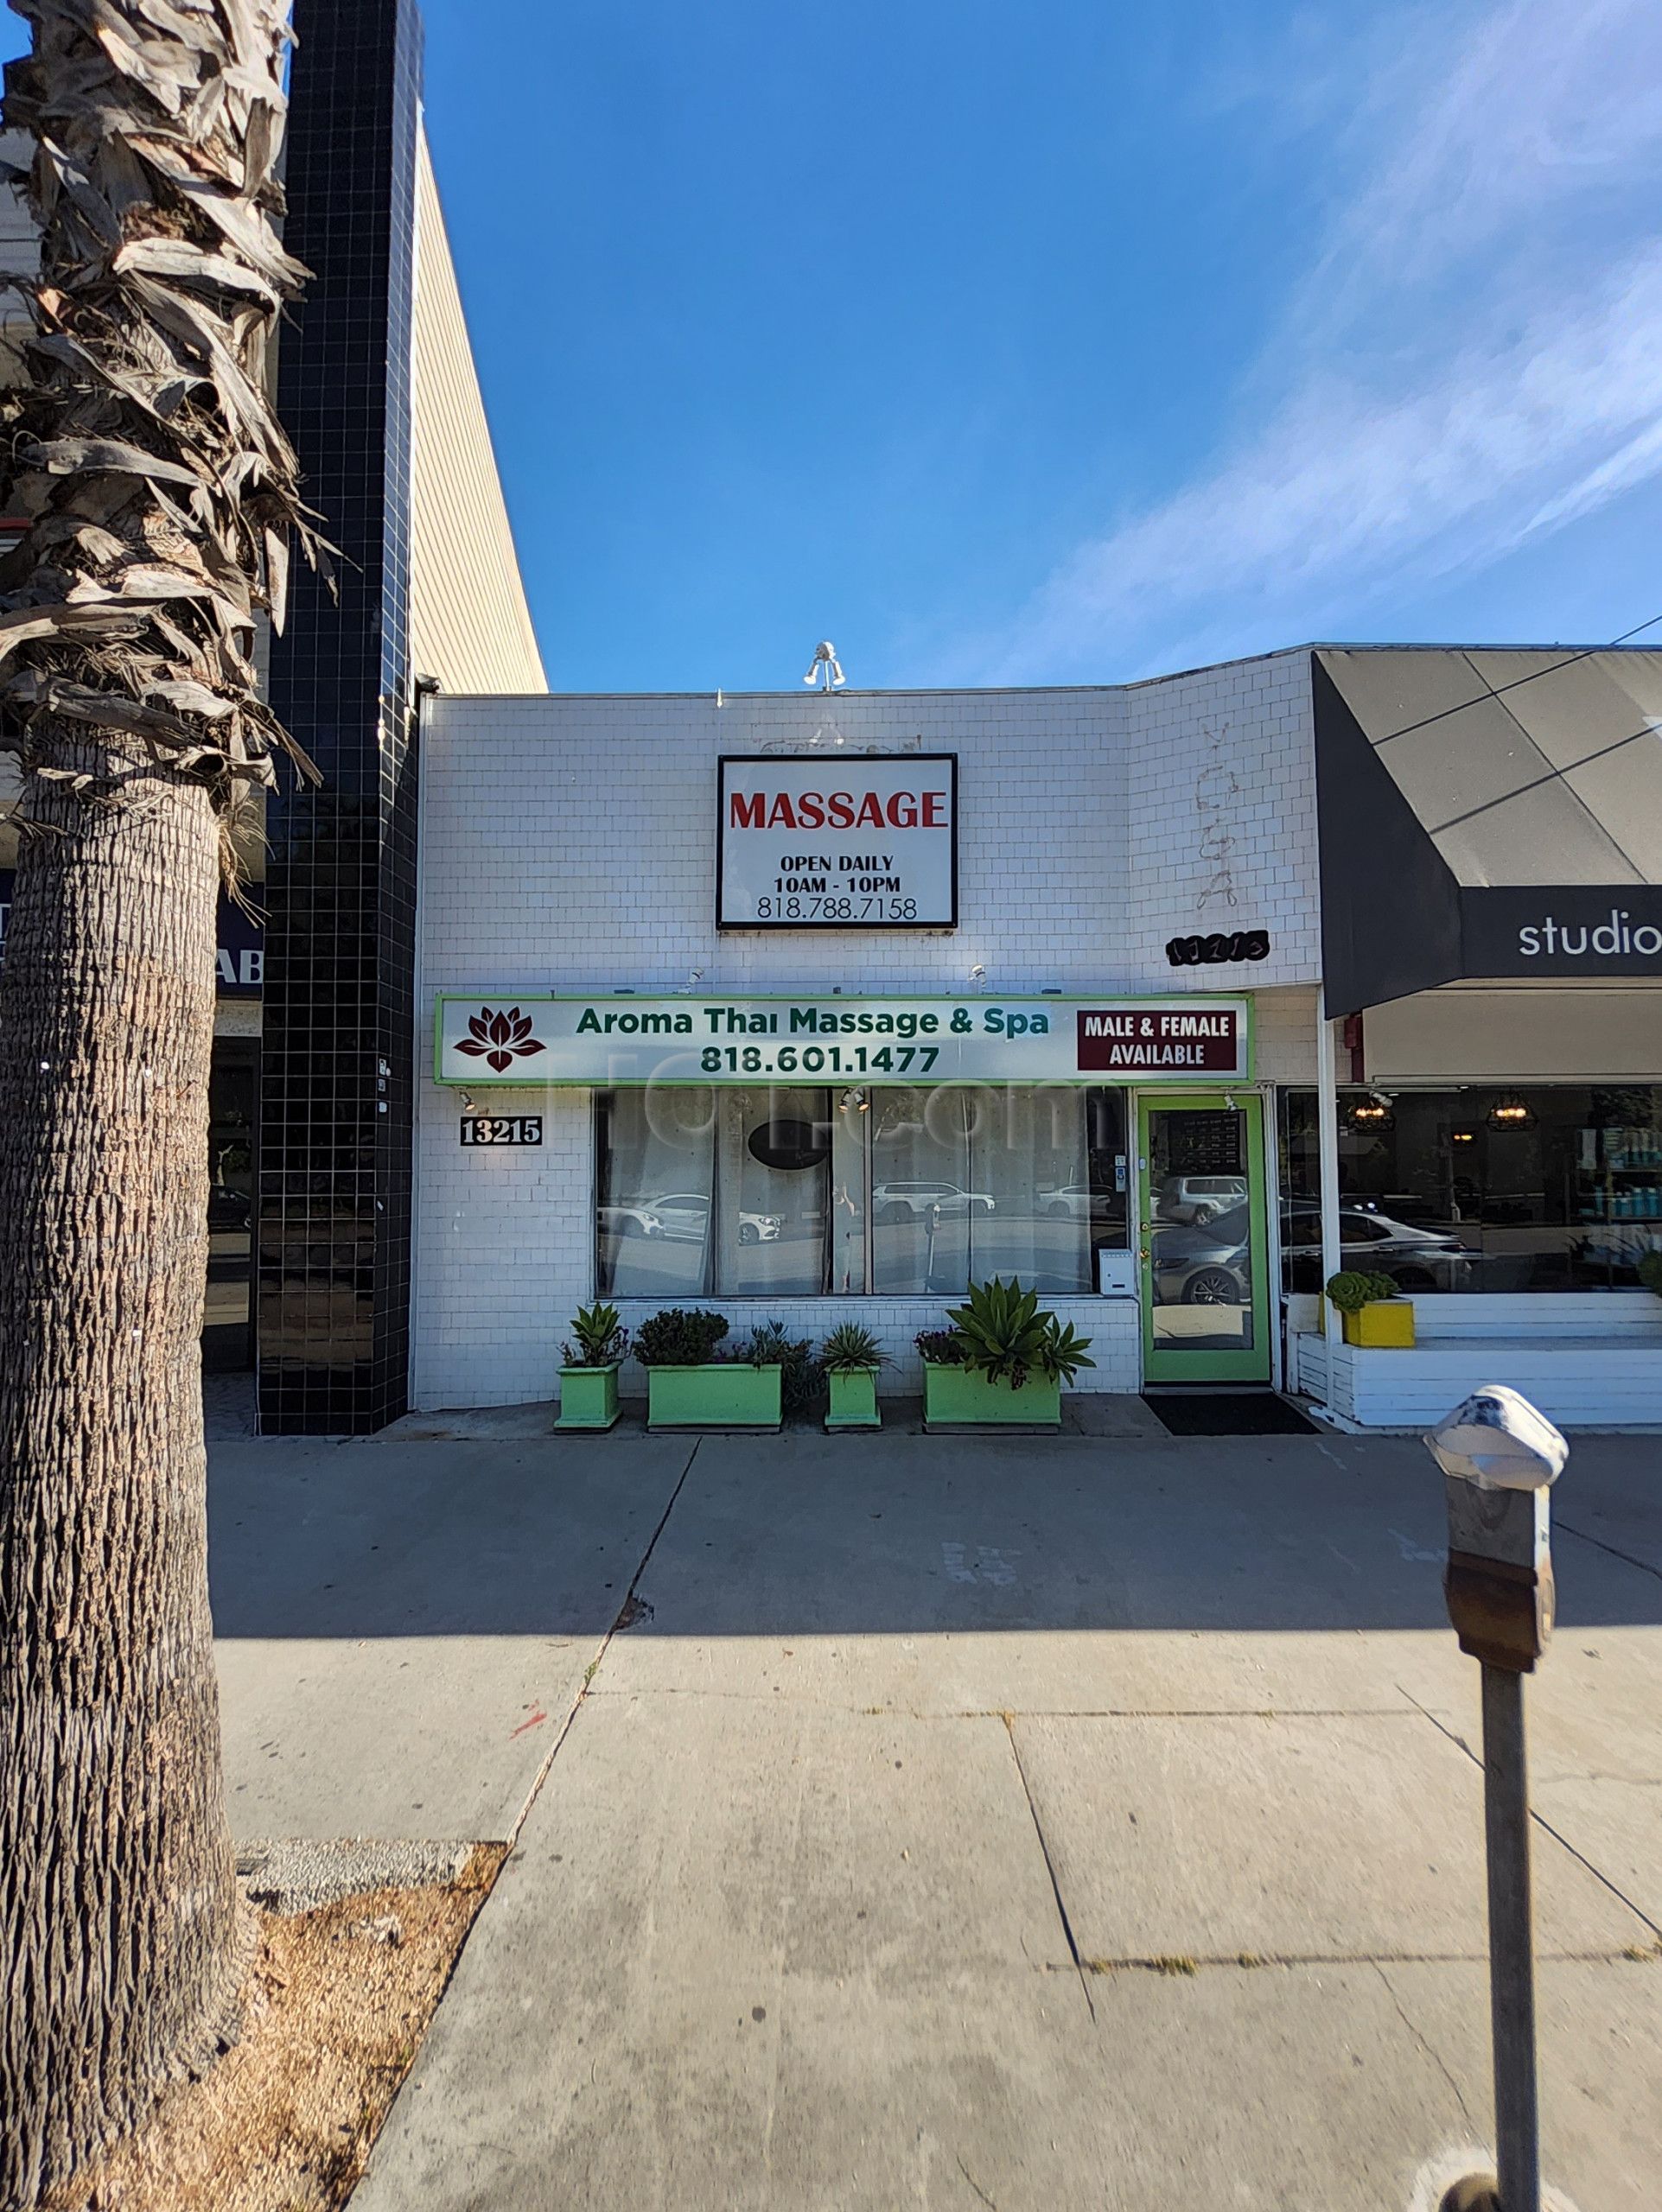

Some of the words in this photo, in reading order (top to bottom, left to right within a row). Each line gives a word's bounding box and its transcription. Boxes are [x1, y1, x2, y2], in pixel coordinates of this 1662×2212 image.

[730, 791, 948, 830] MASSAGE
[780, 855, 831, 872] OPEN
[838, 855, 894, 872] DAILY
[774, 877, 826, 893] 10AM
[846, 876, 901, 893] 10PM
[757, 896, 917, 919] 818.788.7158
[1519, 909, 1662, 956] studio
[576, 1007, 692, 1034] Aroma
[789, 1007, 939, 1038] Massage
[950, 1007, 973, 1033] &
[984, 1007, 1049, 1039] Spa
[1085, 1016, 1134, 1037] MALE
[1140, 1017, 1155, 1037] &
[1161, 1016, 1230, 1037] FEMALE
[700, 1046, 940, 1074] 818.601.1477
[1109, 1044, 1205, 1065] AVAILABLE
[462, 1119, 540, 1143] 13215
